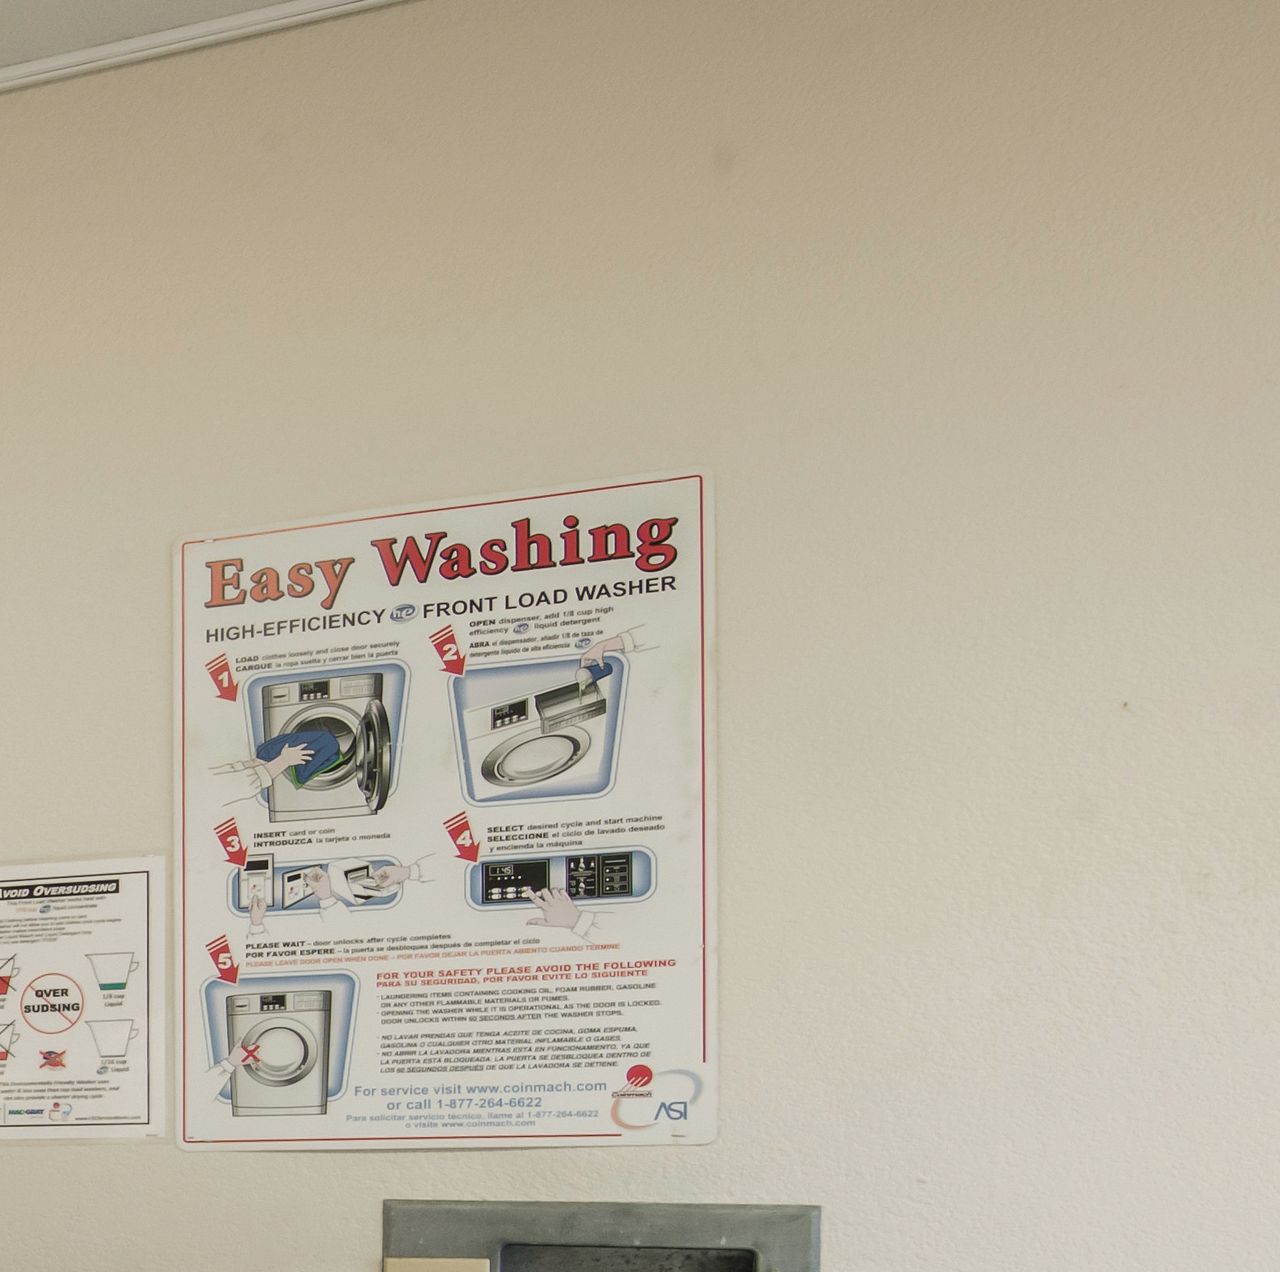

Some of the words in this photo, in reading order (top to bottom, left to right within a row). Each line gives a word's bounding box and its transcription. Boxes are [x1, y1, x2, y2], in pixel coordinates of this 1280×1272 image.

[204, 556, 356, 609] Easy
[371, 515, 678, 587] Washing
[206, 609, 386, 643] HIGH-EFFICIENCY
[423, 597, 498, 618] FRONT
[505, 589, 567, 610] LOAD
[575, 576, 676, 600] WASHER
[443, 644, 458, 660] 2
[218, 672, 229, 687] 1
[487, 825, 524, 833] SELECT
[527, 822, 558, 830] desired
[561, 821, 583, 830] cycle
[603, 817, 623, 825] start
[626, 814, 662, 823] machine
[227, 836, 240, 851] 3
[456, 830, 471, 847] 4
[33, 882, 116, 896] OVERSUDSING
[218, 954, 231, 969] 5
[376, 972, 399, 980] FOR
[403, 970, 435, 979] YOUR
[439, 968, 483, 977] SAFETY
[487, 965, 531, 975] PLEASE
[535, 964, 572, 972] AVOID
[603, 959, 676, 970] FOLLOWING
[35, 988, 68, 998] OVER
[24, 1003, 80, 1013] SUDSING
[354, 1086, 376, 1096] For
[380, 1084, 428, 1095] service
[432, 1084, 461, 1094] visit
[466, 1081, 607, 1094] www.coinmach.com
[387, 1101, 402, 1110] or
[406, 1099, 432, 1109] call
[437, 1097, 542, 1108] 1-877-264-6622
[654, 1102, 687, 1120] ASI
